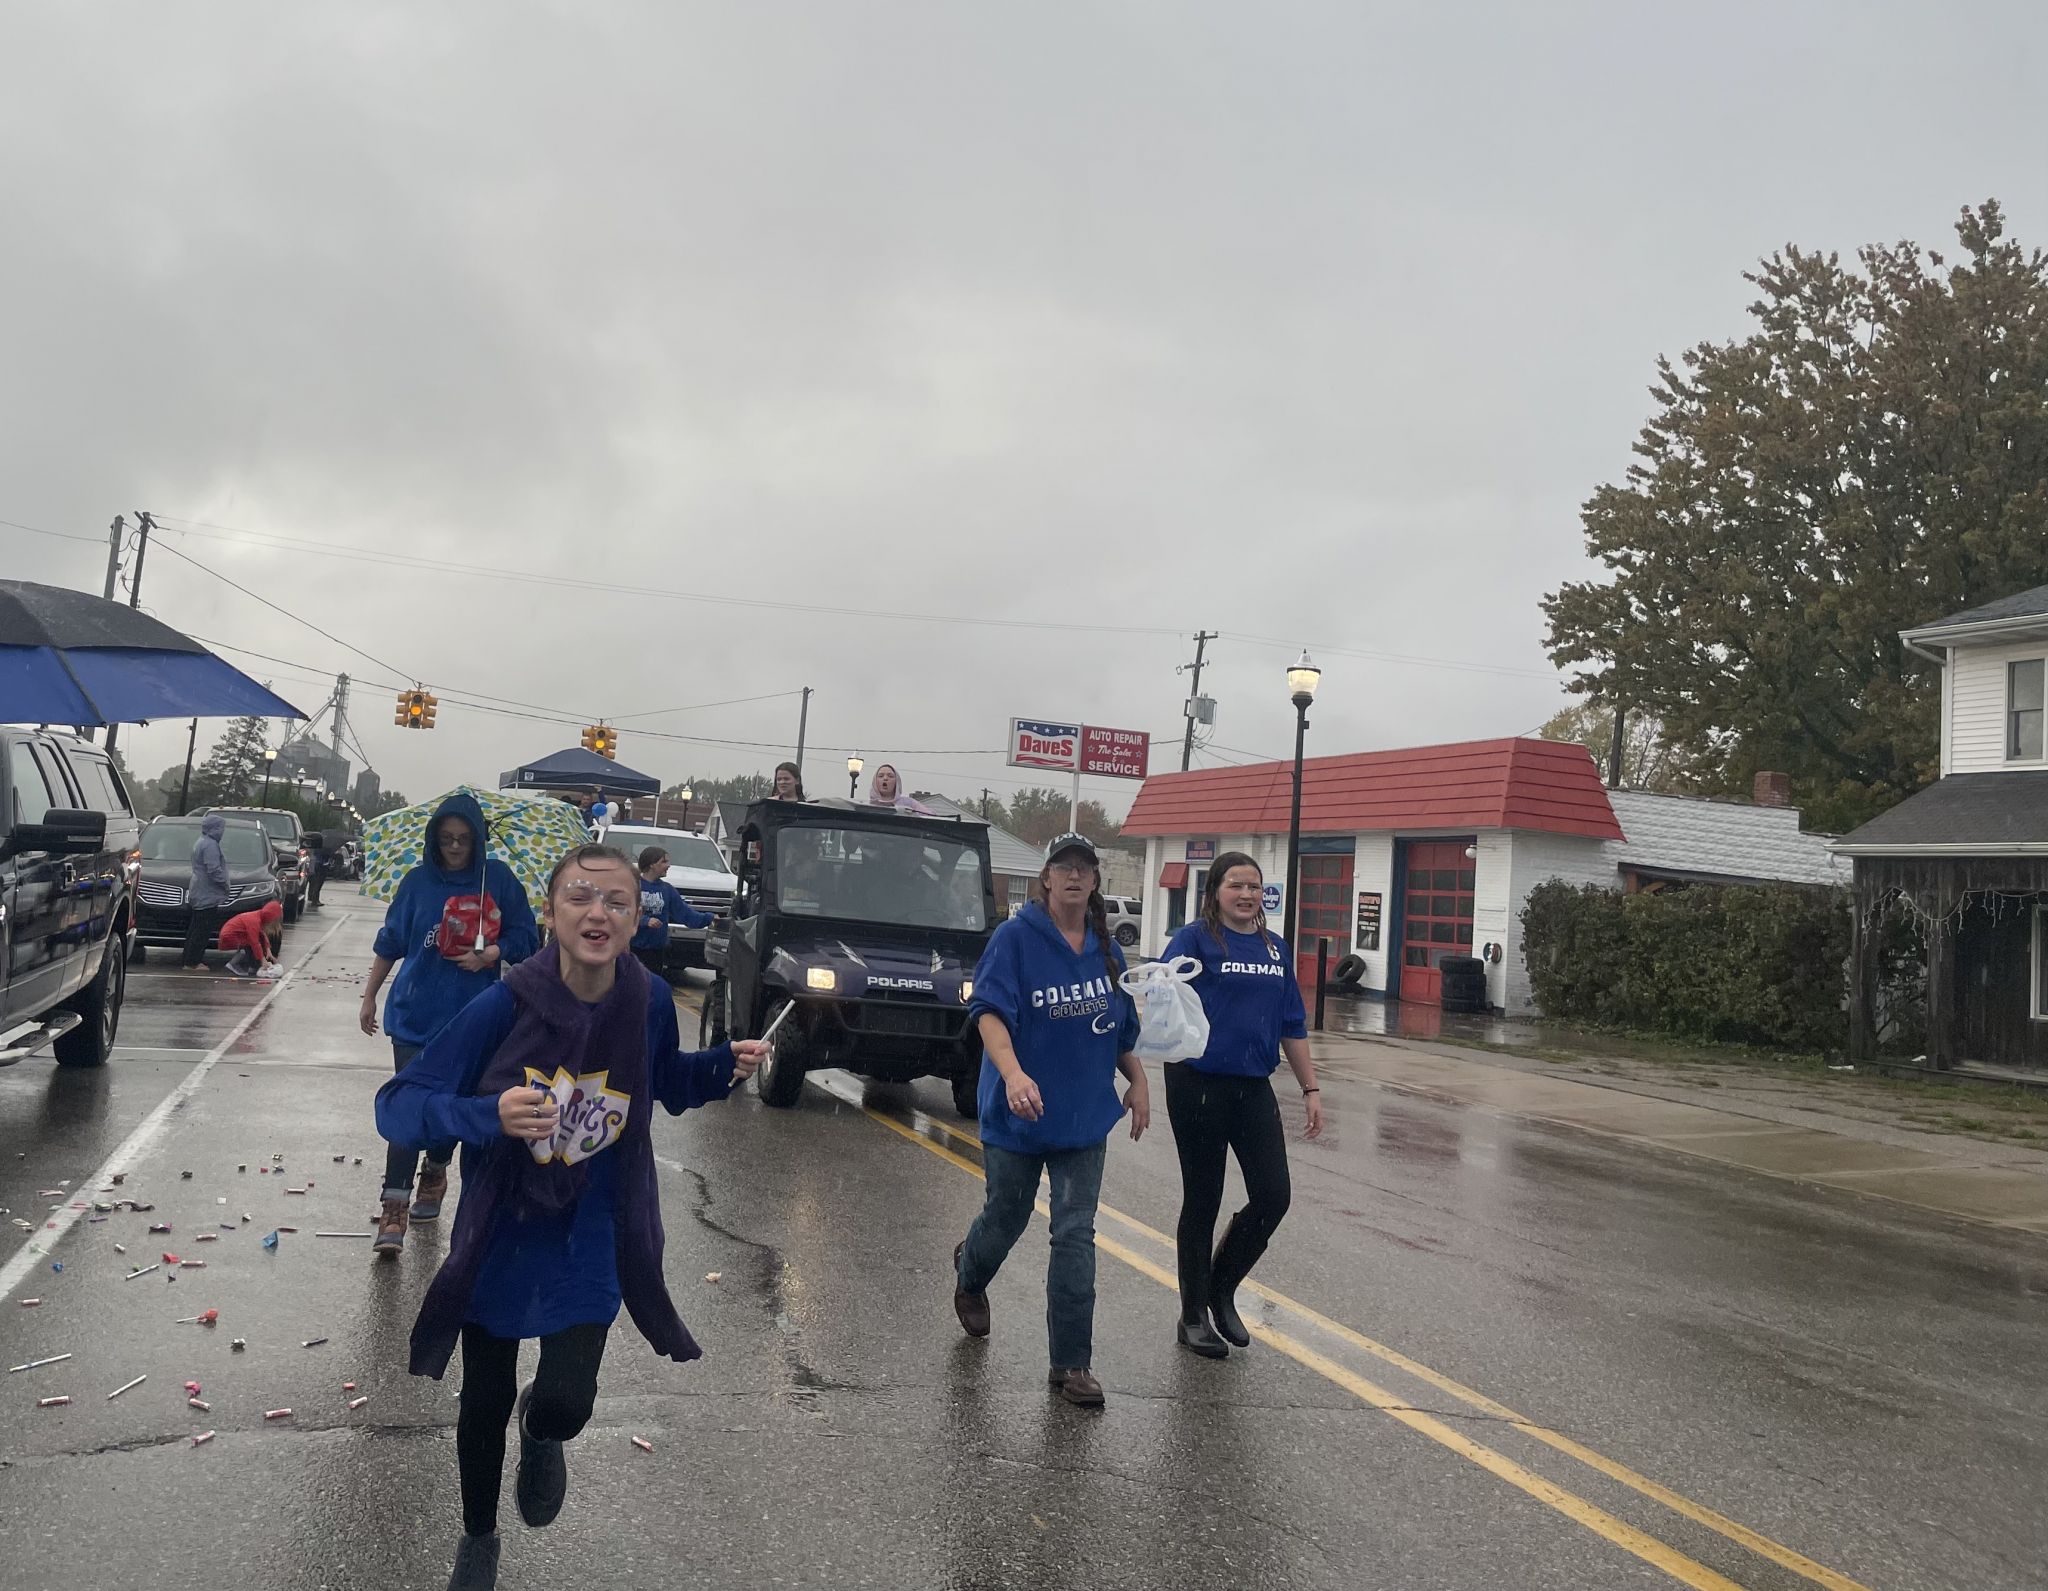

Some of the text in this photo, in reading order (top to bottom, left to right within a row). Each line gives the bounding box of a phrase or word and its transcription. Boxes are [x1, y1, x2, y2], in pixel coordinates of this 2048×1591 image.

[1089, 730, 1142, 745] AUTO REPAIR
[1088, 760, 1140, 775] SERVICE
[1220, 961, 1284, 977] COLEMAN
[867, 976, 934, 990] POLARIS
[1049, 996, 1109, 1020] COMETS
